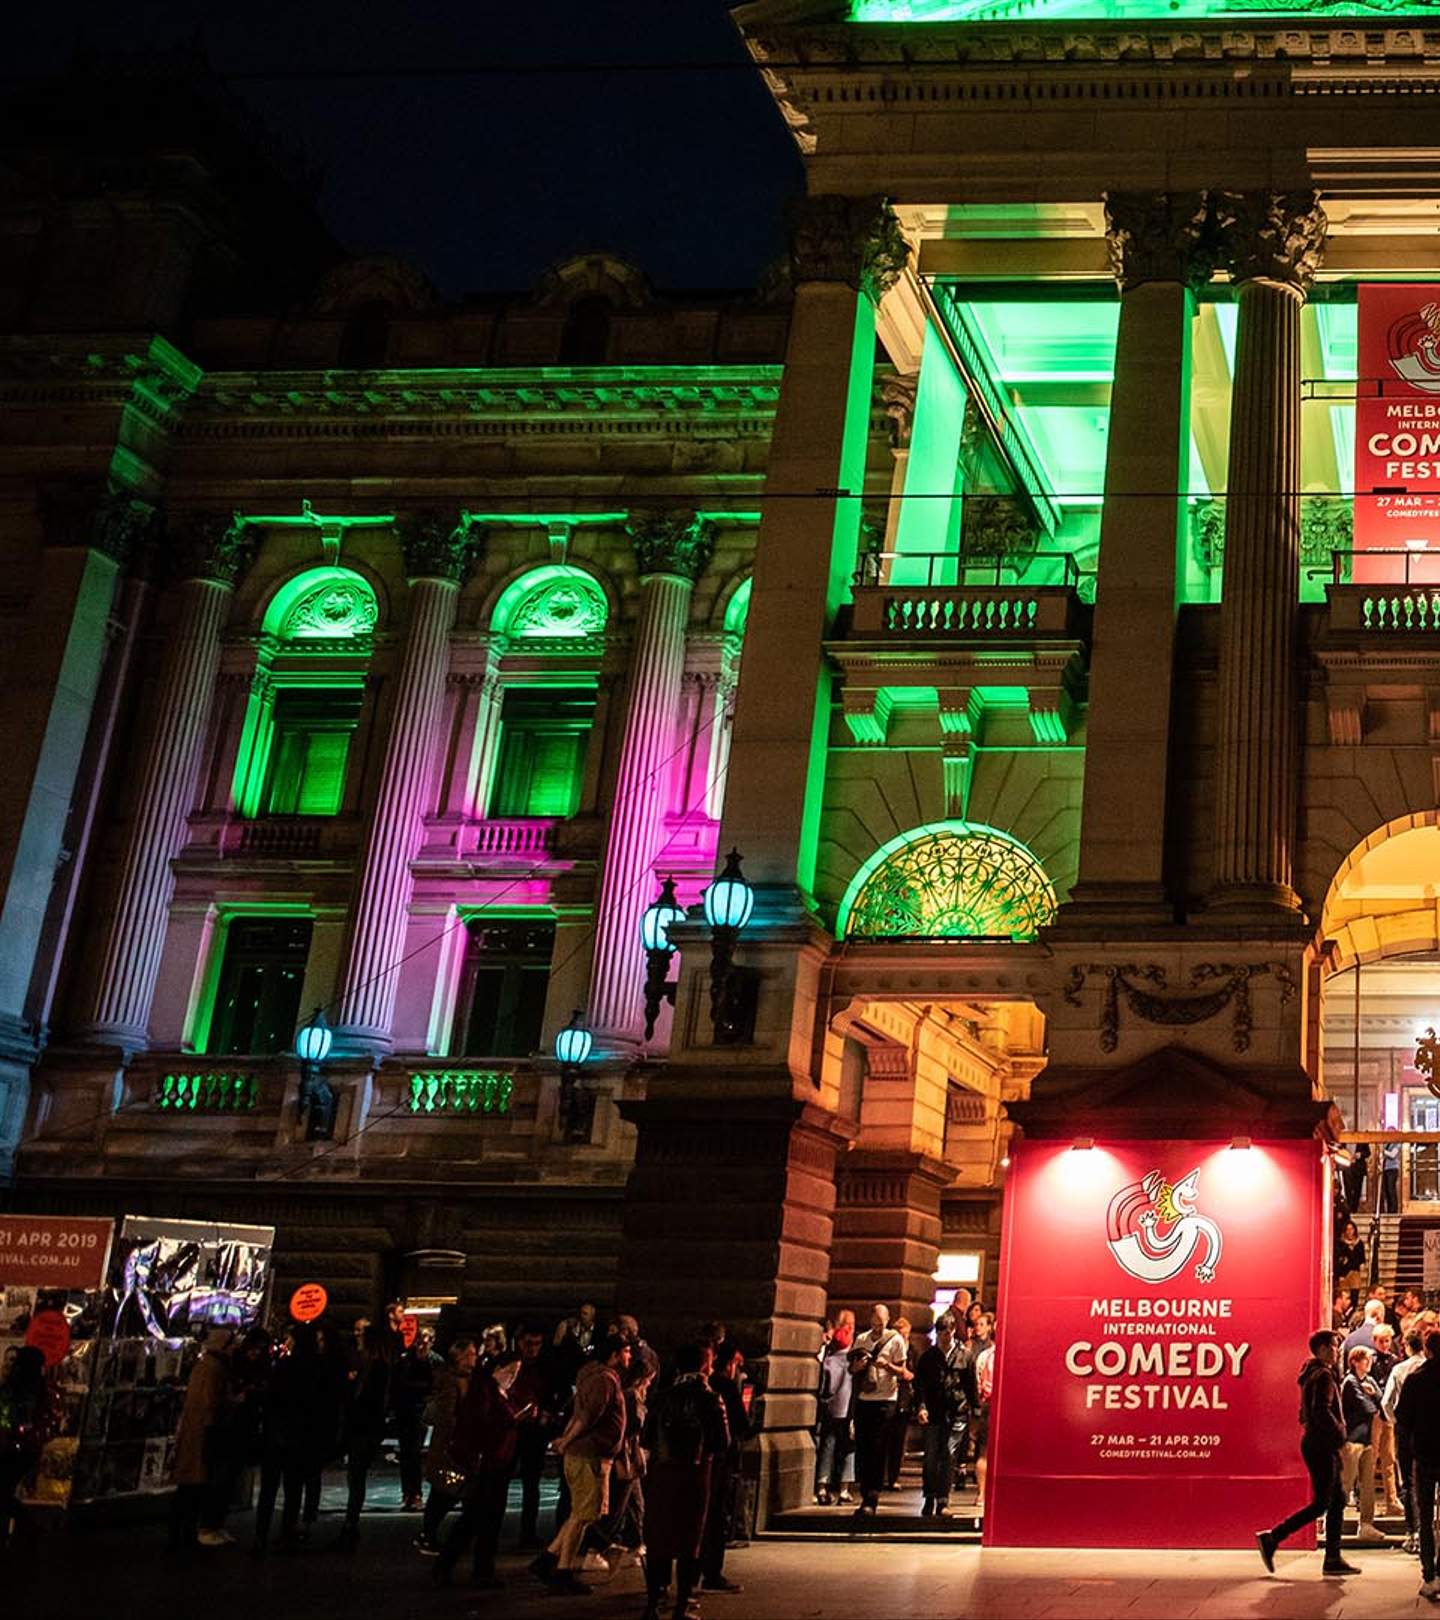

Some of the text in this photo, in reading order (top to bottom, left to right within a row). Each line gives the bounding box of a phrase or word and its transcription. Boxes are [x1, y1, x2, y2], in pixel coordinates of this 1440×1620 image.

[1376, 497, 1391, 507] 27
[1394, 497, 1422, 506] MAR
[17, 1232, 52, 1247] APR
[57, 1232, 97, 1248] 2019
[1090, 1299, 1232, 1317] MELBOURNE
[1103, 1322, 1217, 1336] INTERNATIONAL
[1065, 1341, 1250, 1377] COMEDY
[1085, 1384, 1228, 1410] FESTIVAL
[1090, 1435, 1105, 1446] 27
[1107, 1434, 1135, 1445] MAR
[1149, 1434, 1162, 1445] 21
[1164, 1435, 1189, 1445] APR
[1192, 1434, 1221, 1446] 2019
[1099, 1449, 1211, 1459] COMEDYFESTIVAL.COM.AU
